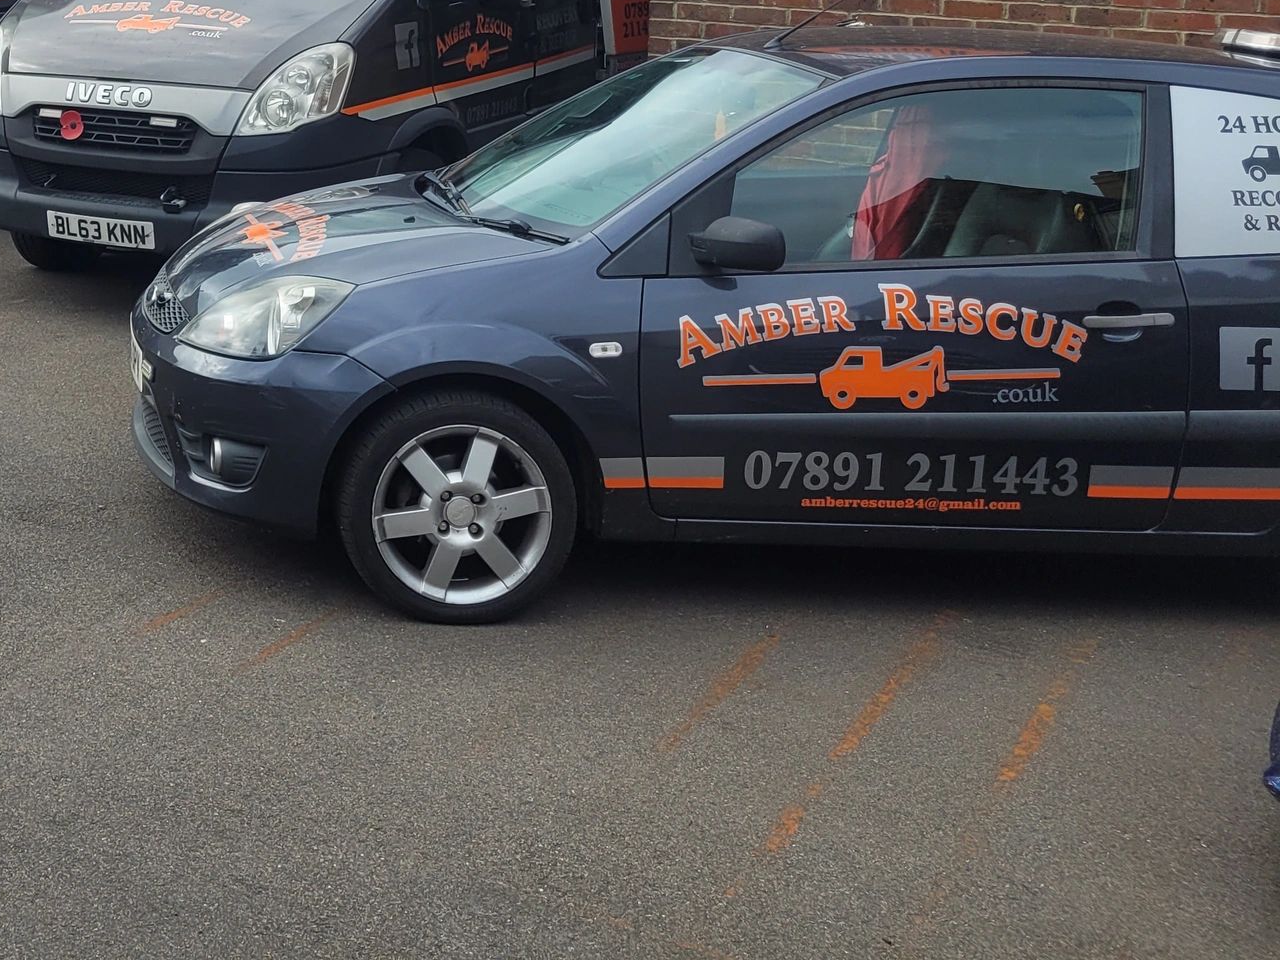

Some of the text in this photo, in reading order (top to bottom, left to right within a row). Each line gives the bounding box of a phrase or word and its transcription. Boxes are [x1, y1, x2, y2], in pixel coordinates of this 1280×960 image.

[63, 0, 252, 28] AMBER RESCUE
[188, 30, 223, 39] .co.uk
[435, 21, 472, 58] AMBER
[475, 13, 513, 41] RESCUE
[65, 81, 153, 107] IVECO
[1217, 115, 1247, 133] 24
[1231, 190, 1280, 207] REC
[54, 215, 146, 245] BL63 KNN
[1244, 213, 1261, 231] &
[677, 282, 1089, 369] AMBER RESCUE
[991, 382, 1061, 404] .co.uk
[743, 450, 1080, 497] 07891 211443
[800, 495, 1021, 513] amberrescue24@gmail.com
